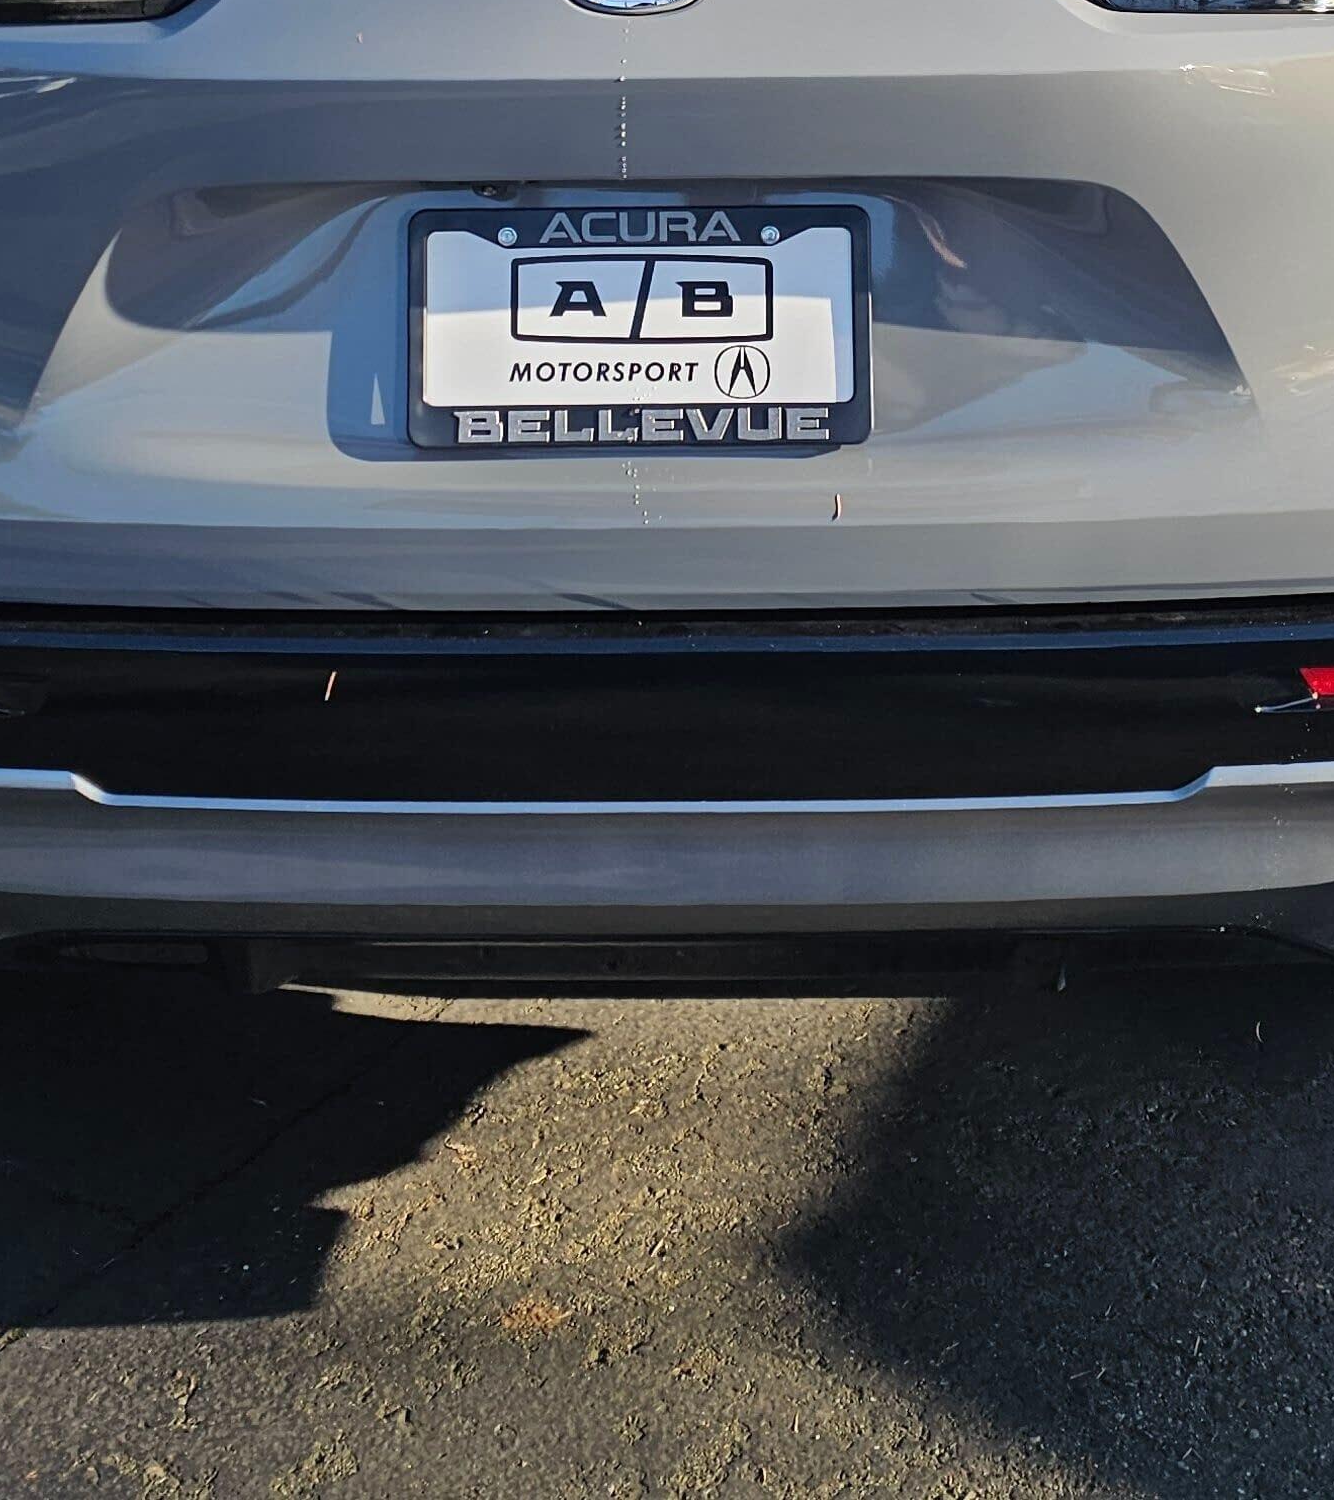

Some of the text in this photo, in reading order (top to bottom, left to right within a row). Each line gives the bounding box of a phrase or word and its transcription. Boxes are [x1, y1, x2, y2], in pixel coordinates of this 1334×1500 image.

[539, 211, 741, 243] ACURA
[509, 362, 699, 383] MOTORSPORT
[454, 407, 830, 444] BELLEVUE
